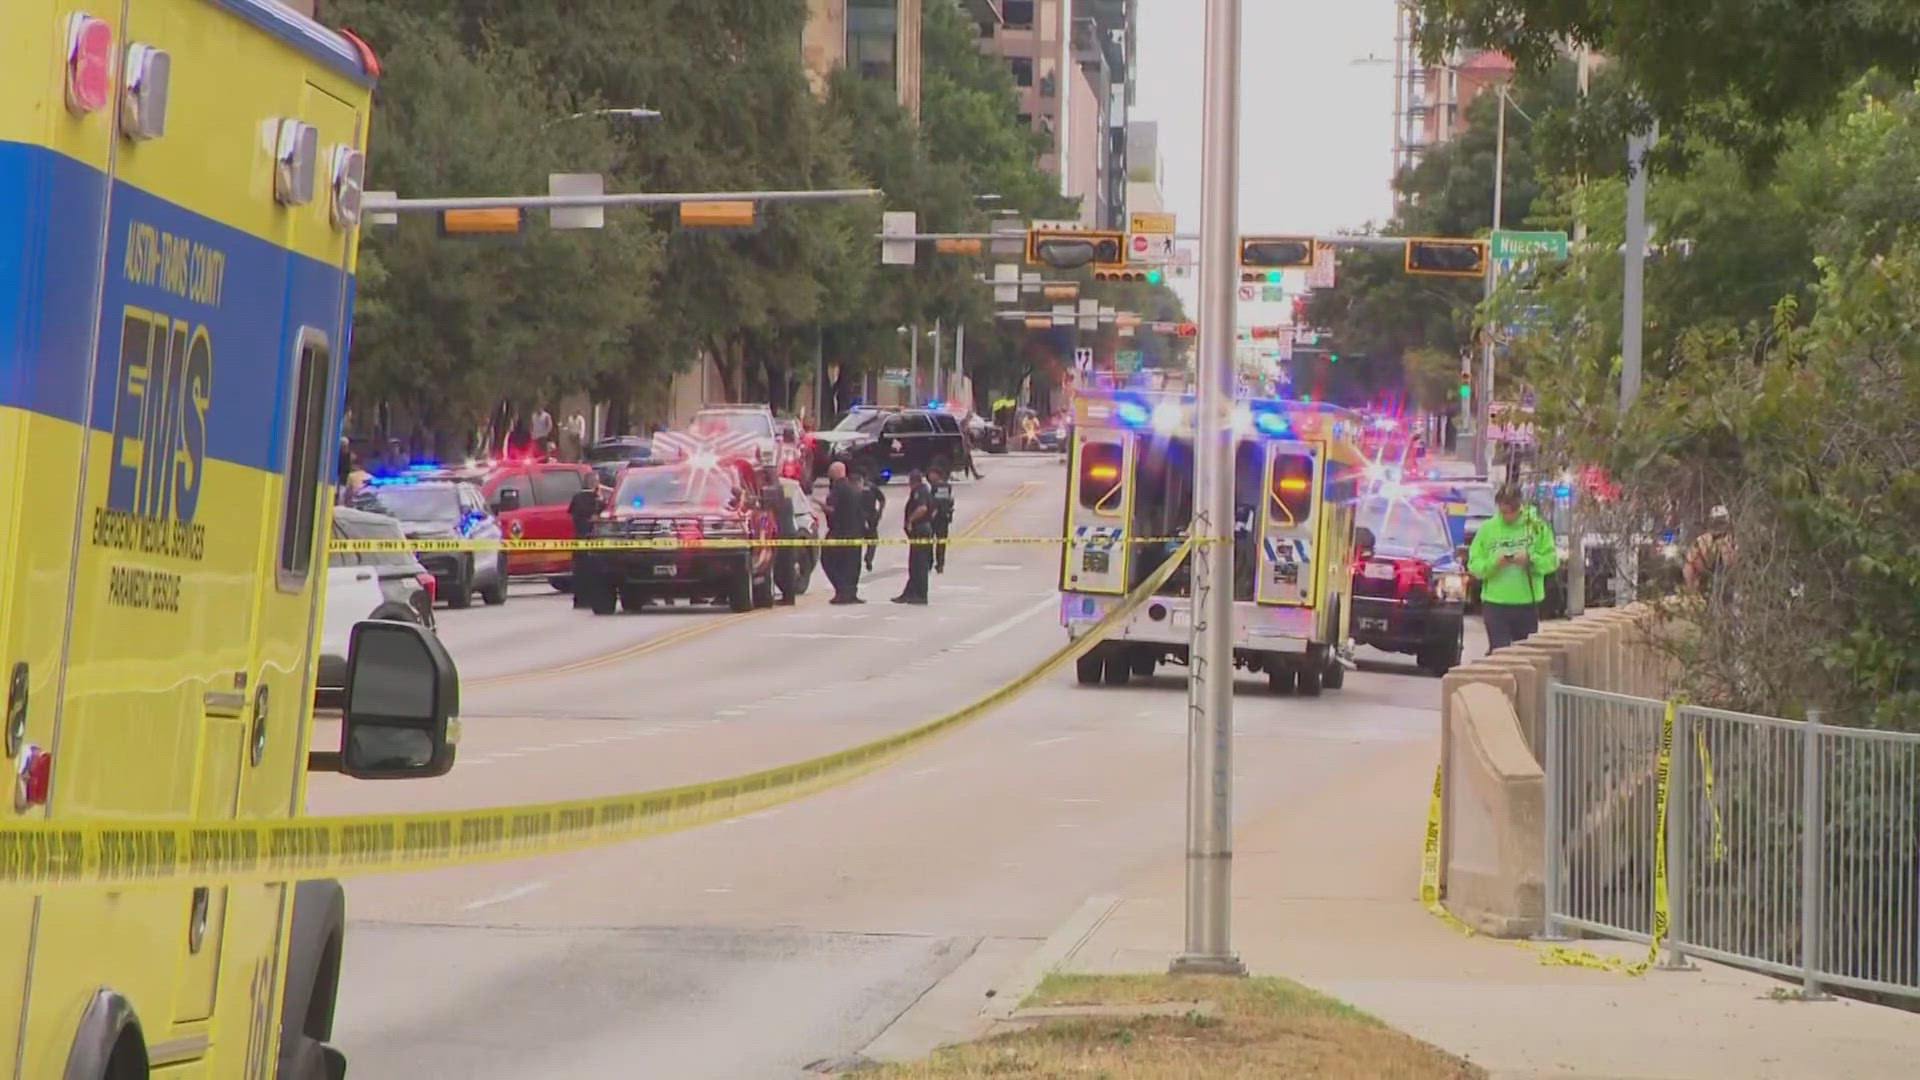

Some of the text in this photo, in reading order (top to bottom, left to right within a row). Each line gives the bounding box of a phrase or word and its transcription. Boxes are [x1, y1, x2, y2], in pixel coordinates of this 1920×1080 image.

[107, 304, 212, 524] EMS
[93, 507, 205, 561] EMERGENCY MEDICAL SERVICES
[108, 566, 181, 613] PARAMEDIC RESCUE
